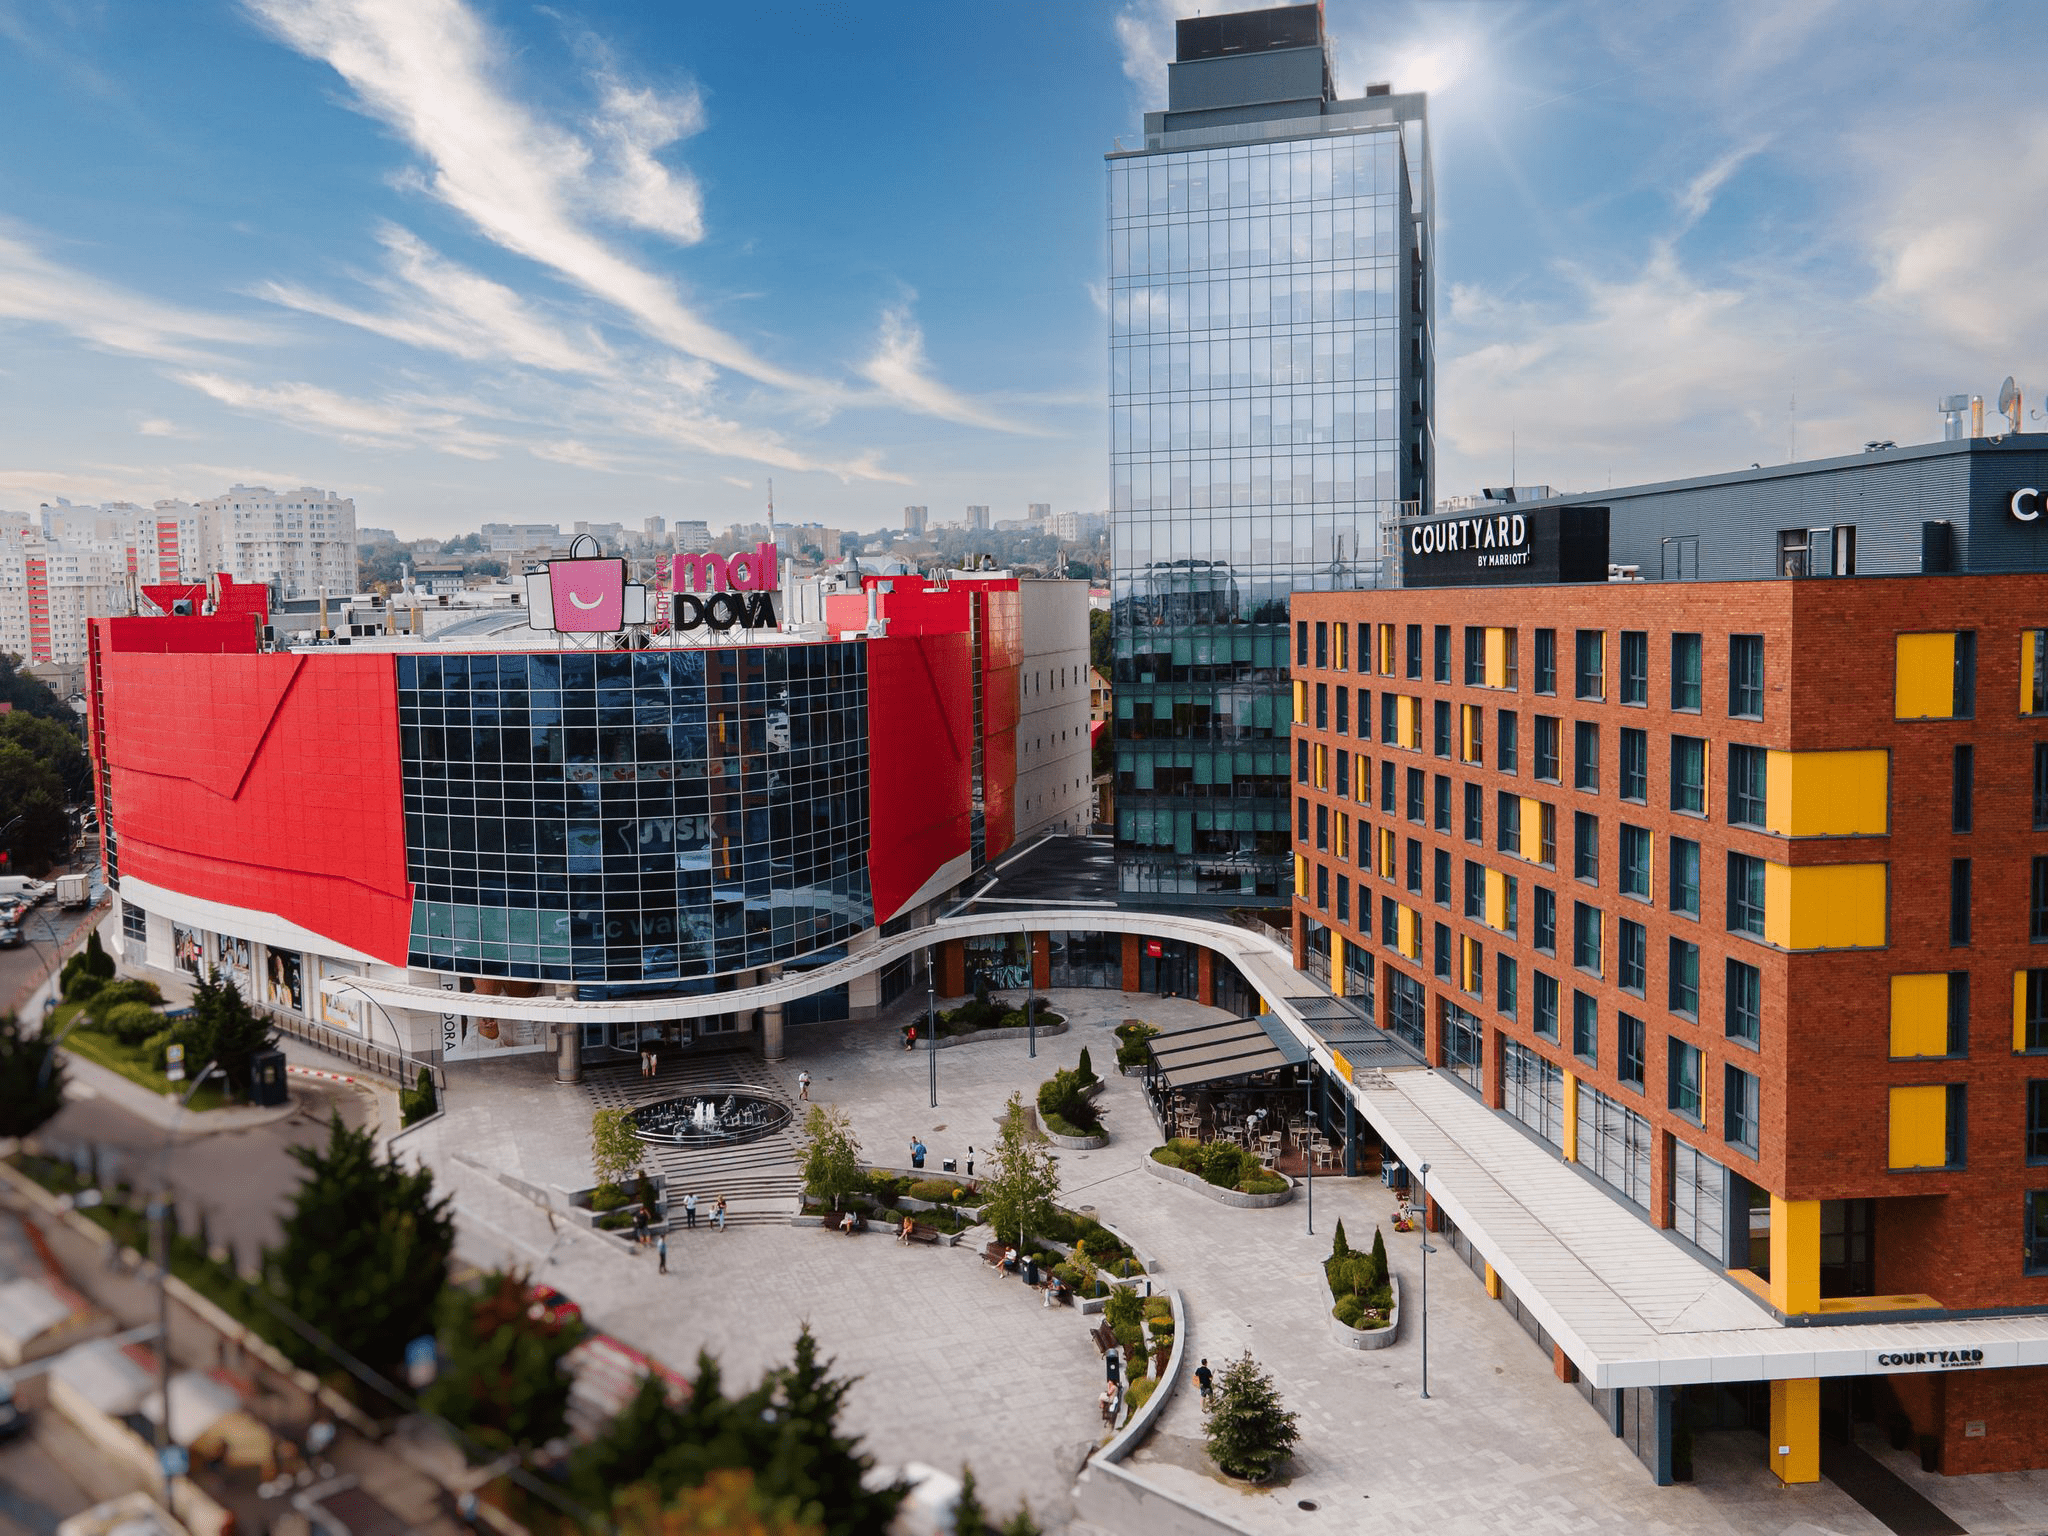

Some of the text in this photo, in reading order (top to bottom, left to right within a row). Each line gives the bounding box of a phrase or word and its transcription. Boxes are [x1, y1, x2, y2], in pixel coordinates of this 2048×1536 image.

[1411, 514, 1526, 555] COURTYARD
[672, 542, 778, 592] mall
[1477, 552, 1527, 567] BY MARRIOTT
[674, 592, 778, 631] DOVA
[639, 816, 718, 844] JYSK
[1878, 1349, 1984, 1367] COURTYARD
